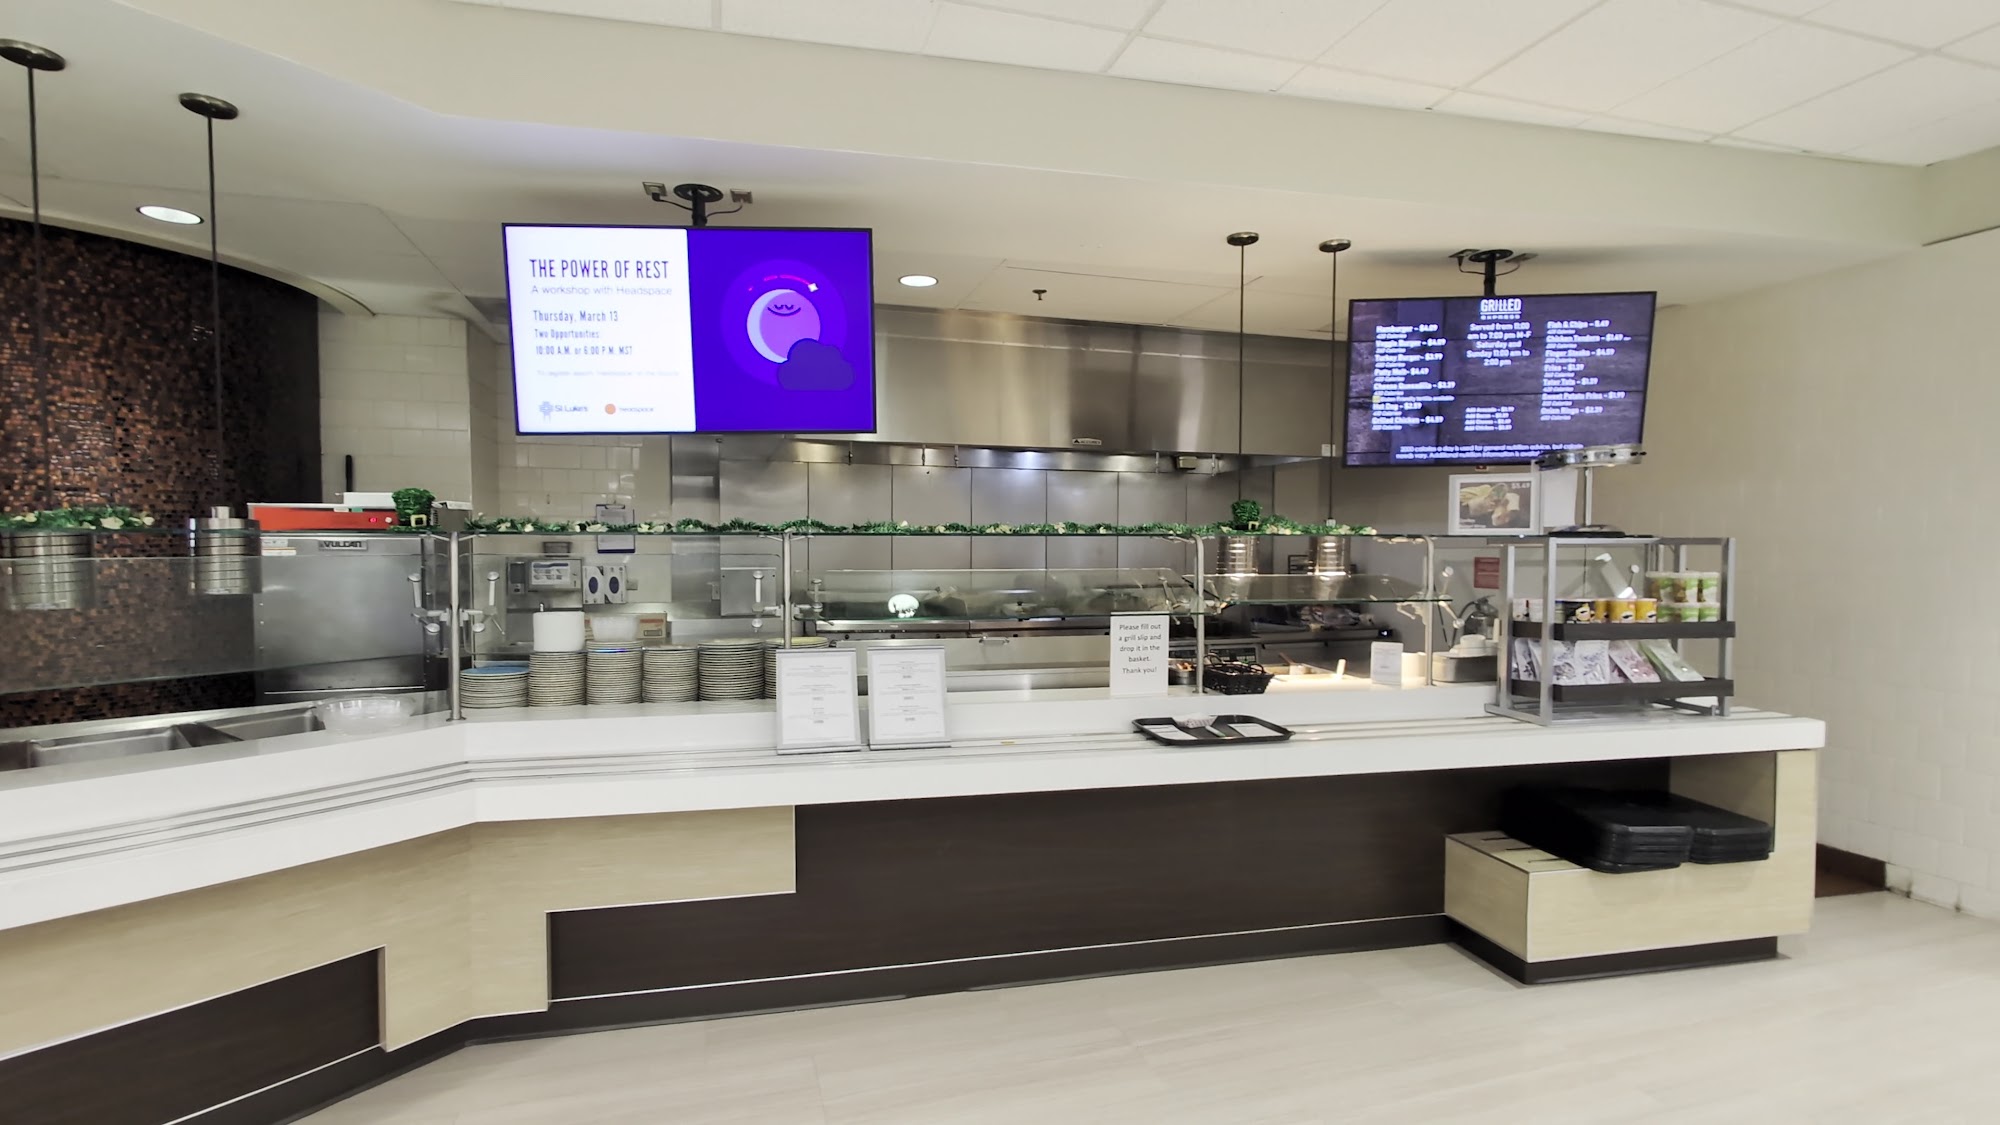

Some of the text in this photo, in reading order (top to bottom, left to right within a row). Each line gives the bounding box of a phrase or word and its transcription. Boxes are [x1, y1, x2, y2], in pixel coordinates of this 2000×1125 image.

[529, 259, 669, 279] THE POWER OF REST
[531, 285, 672, 296] A workshop with Headspace
[1480, 298, 1521, 312] GRILLED
[580, 310, 606, 321] March
[610, 310, 618, 321] 13
[1470, 323, 1495, 331] Served
[1569, 321, 1588, 329] Chips
[535, 329, 548, 338] Two
[1476, 340, 1522, 349] Saturday and
[575, 347, 581, 355] or
[619, 346, 632, 355] MST
[1467, 350, 1492, 358] Sunday
[1484, 358, 1499, 366] 2:00
